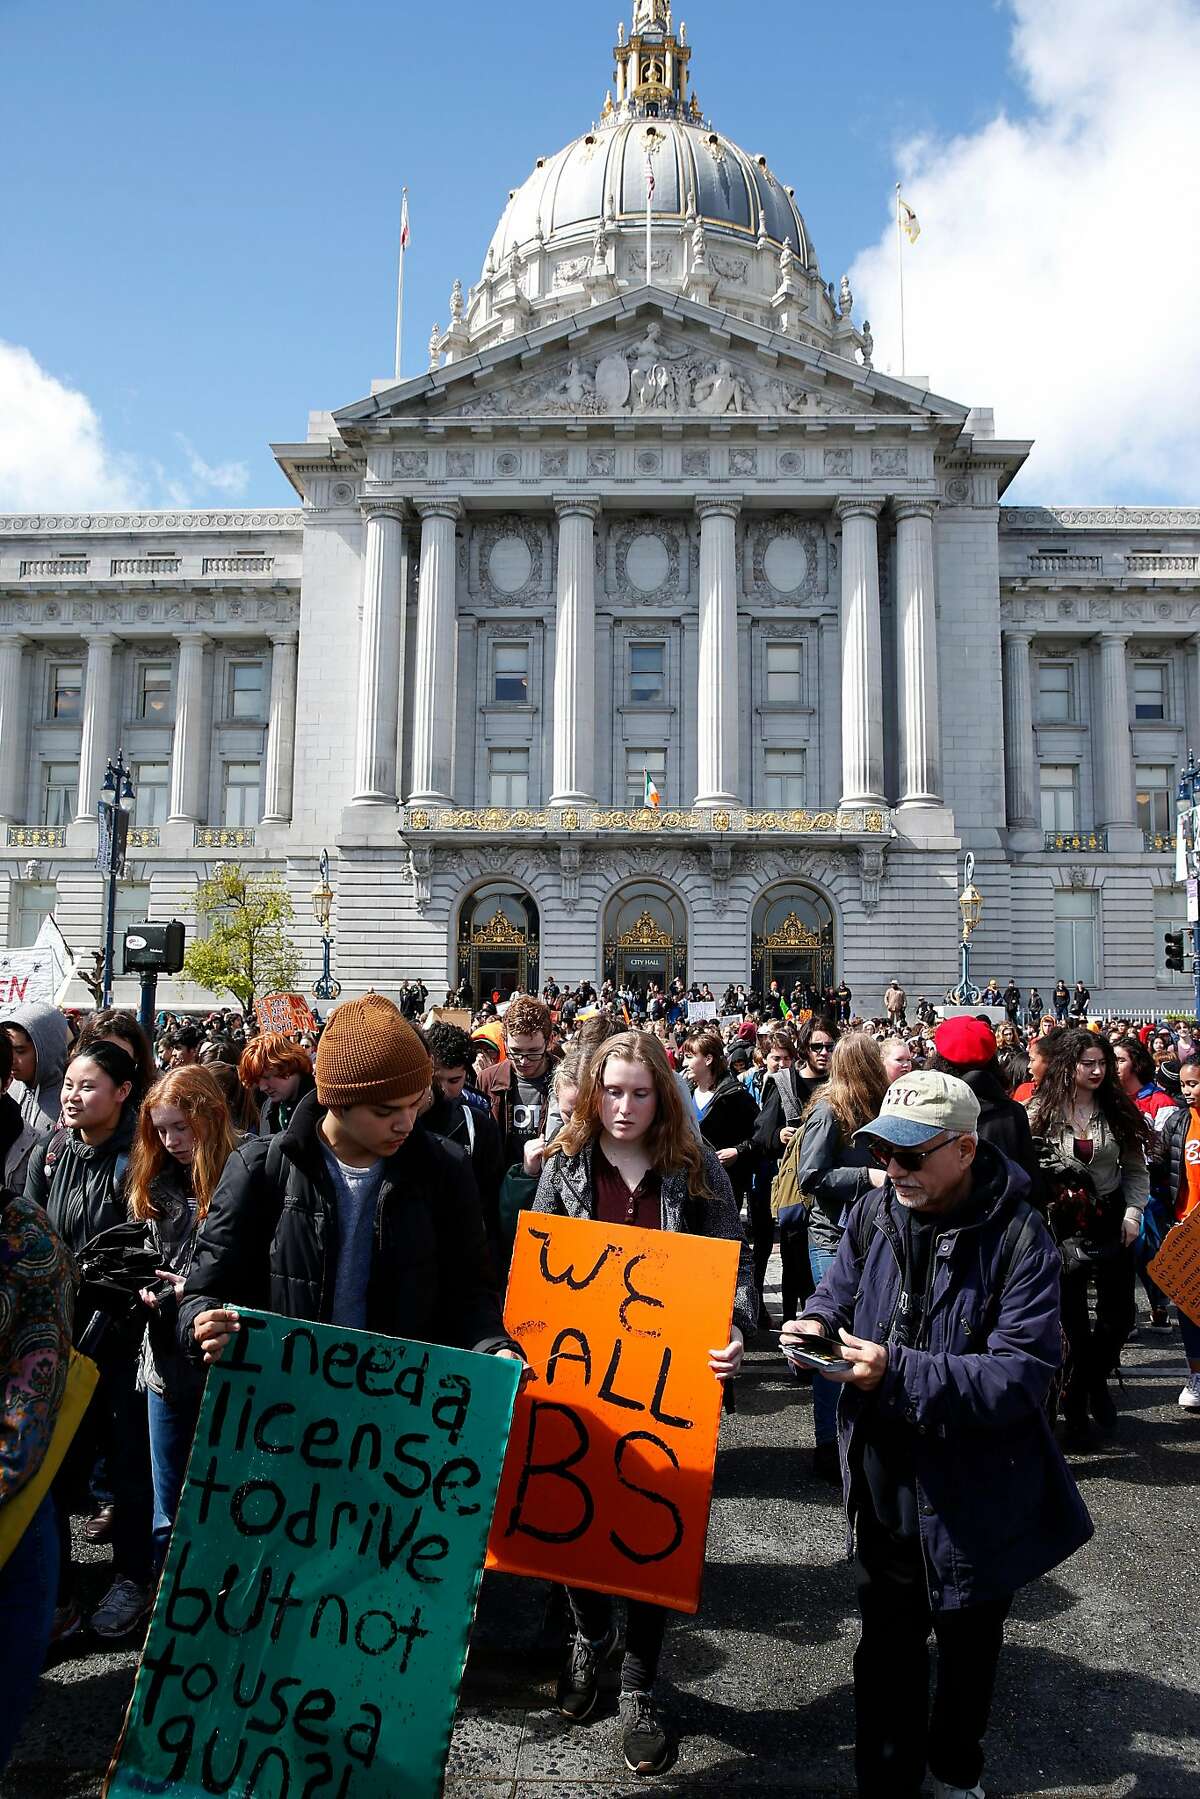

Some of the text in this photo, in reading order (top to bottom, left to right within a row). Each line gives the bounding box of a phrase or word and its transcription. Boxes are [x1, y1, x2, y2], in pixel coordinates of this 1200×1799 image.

[528, 1228, 664, 1338] WE
[216, 1318, 472, 1445] I need a
[546, 1328, 694, 1429] ALL
[207, 1380, 481, 1516] license
[504, 1399, 684, 1565] BS
[190, 1455, 449, 1583] to drive
[165, 1541, 429, 1673] but not
[141, 1637, 382, 1768] to use a
